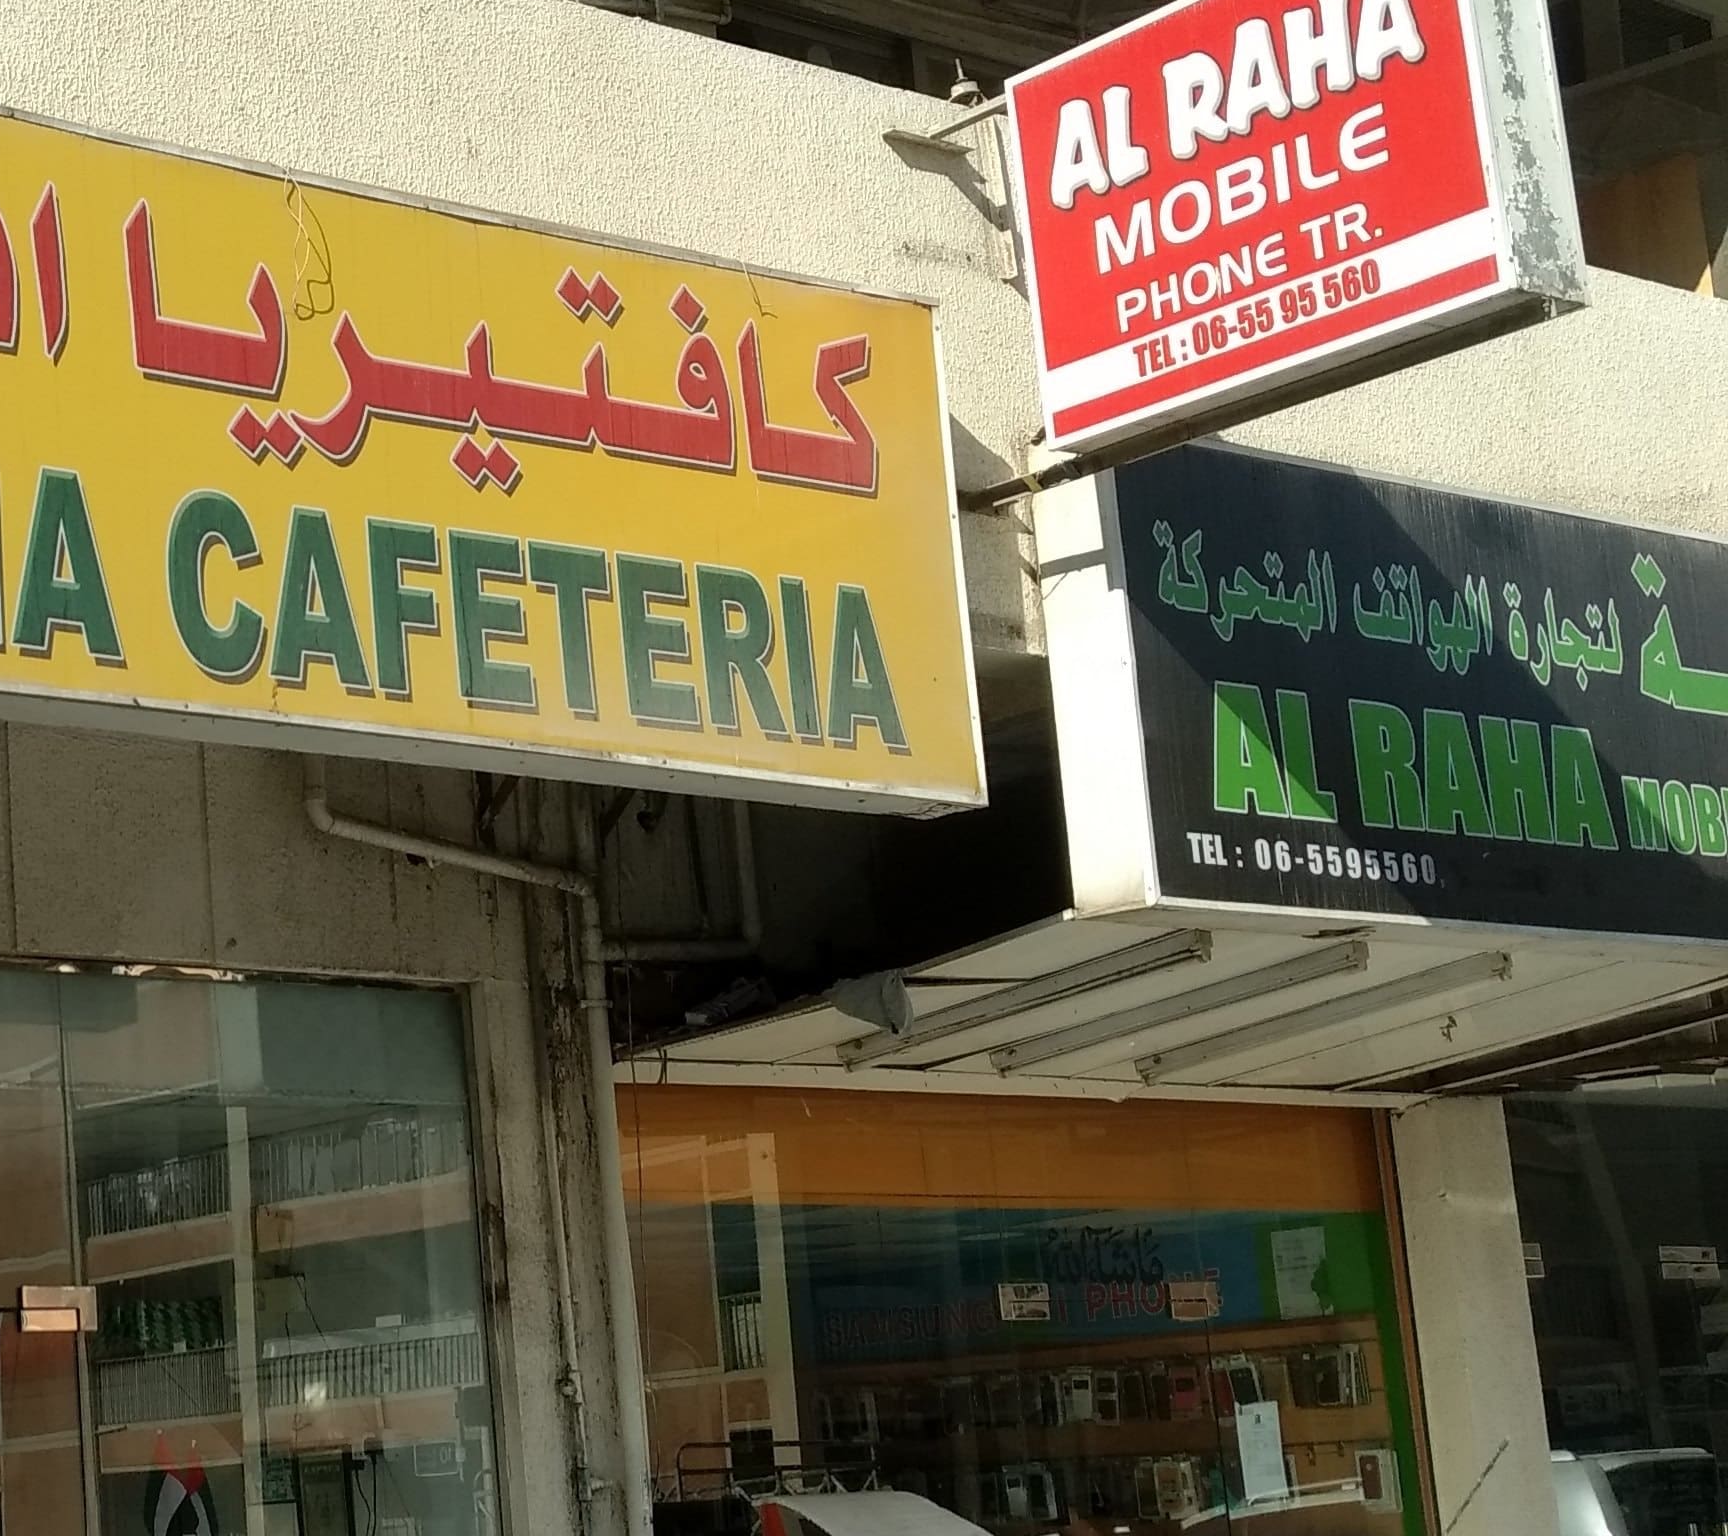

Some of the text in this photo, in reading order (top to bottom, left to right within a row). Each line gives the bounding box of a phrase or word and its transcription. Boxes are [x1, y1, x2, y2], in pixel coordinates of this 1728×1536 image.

[1049, 82, 1149, 211] AL
[1092, 103, 1392, 276] MOBILE
[1115, 202, 1385, 334] PHONE TR.
[1191, 296, 1274, 357] 06-55
[1323, 257, 1382, 310] 560
[122, 198, 878, 496] كافتيريا
[165, 489, 914, 757] CAFETERIA
[1151, 519, 1338, 644] المتحركة
[1353, 562, 1494, 677] الهواتف
[1502, 581, 1624, 693] لتجارة
[1213, 680, 1728, 858] AL RAHA MOB
